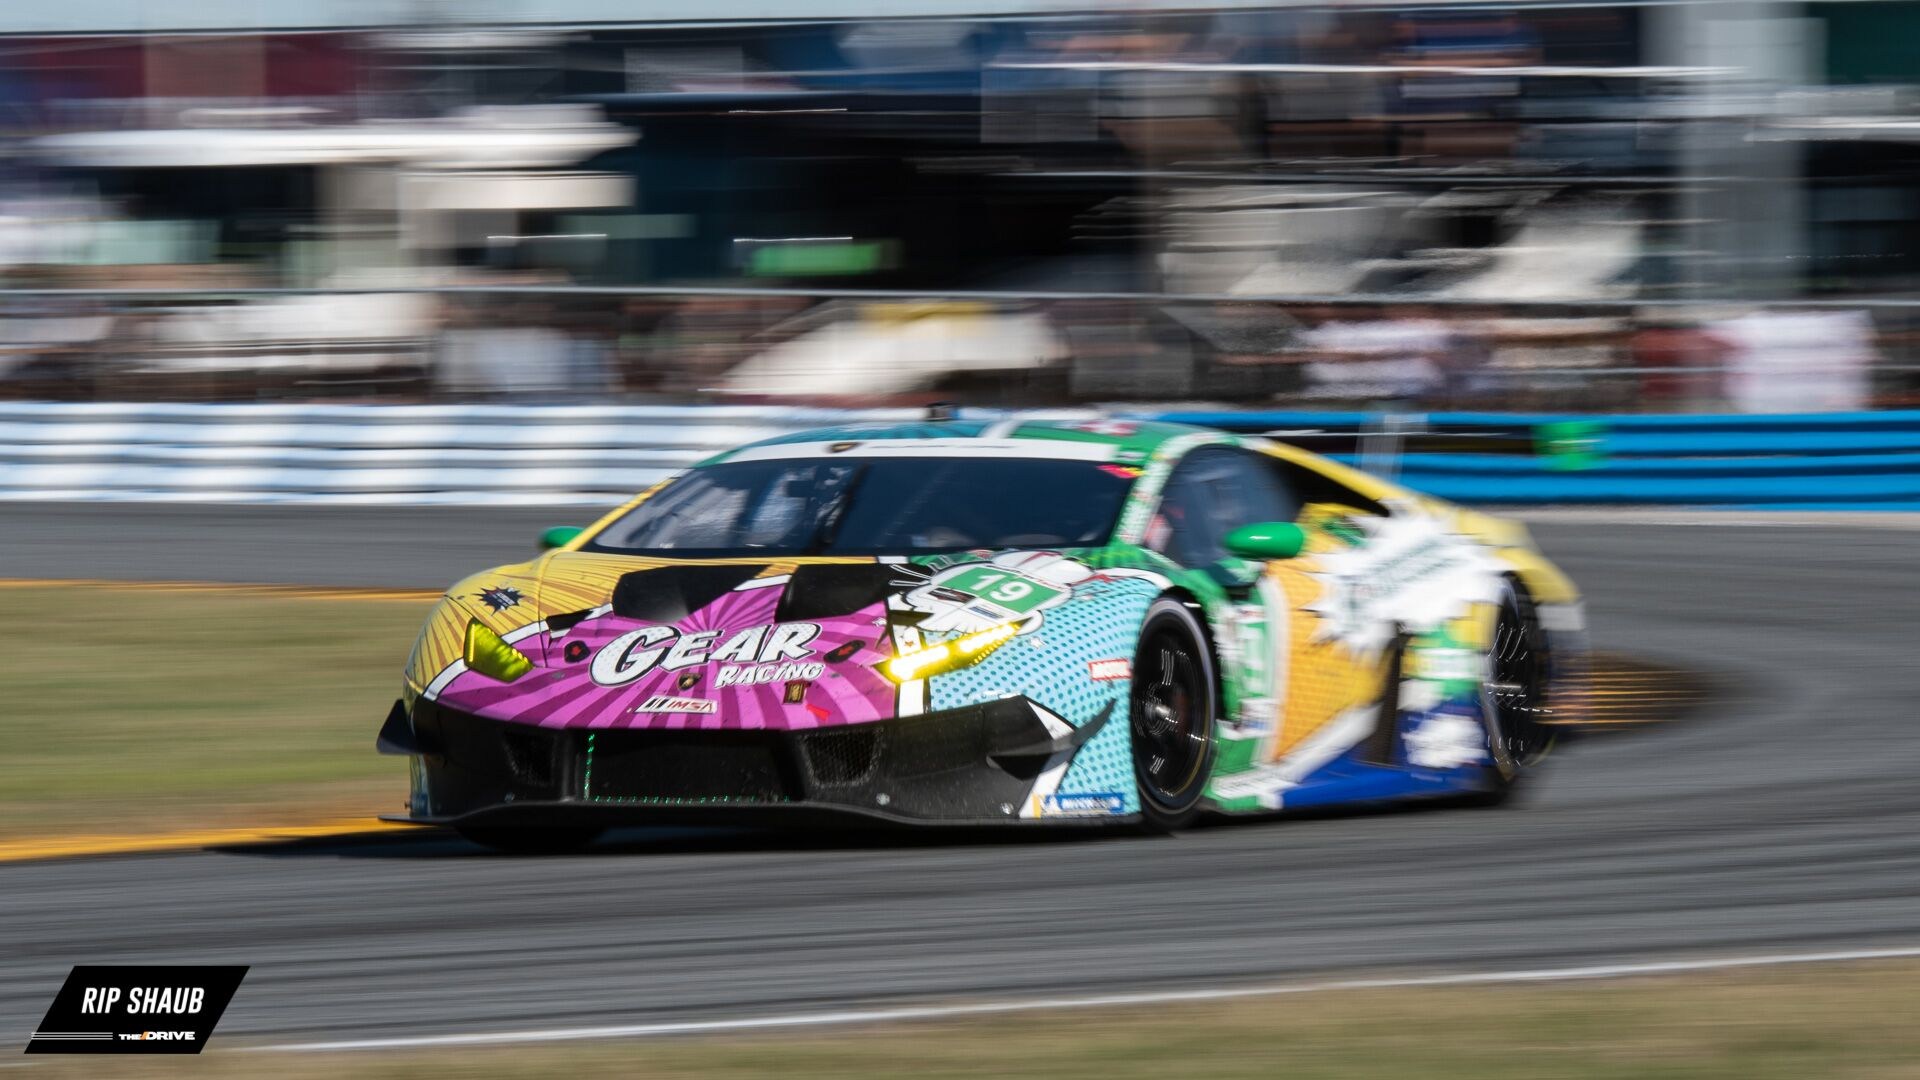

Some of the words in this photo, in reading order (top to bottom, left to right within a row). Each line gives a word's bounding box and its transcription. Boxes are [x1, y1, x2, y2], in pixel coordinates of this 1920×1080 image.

[969, 574, 1034, 602] 19
[589, 623, 822, 688] GEAR
[668, 700, 715, 710] IMSA
